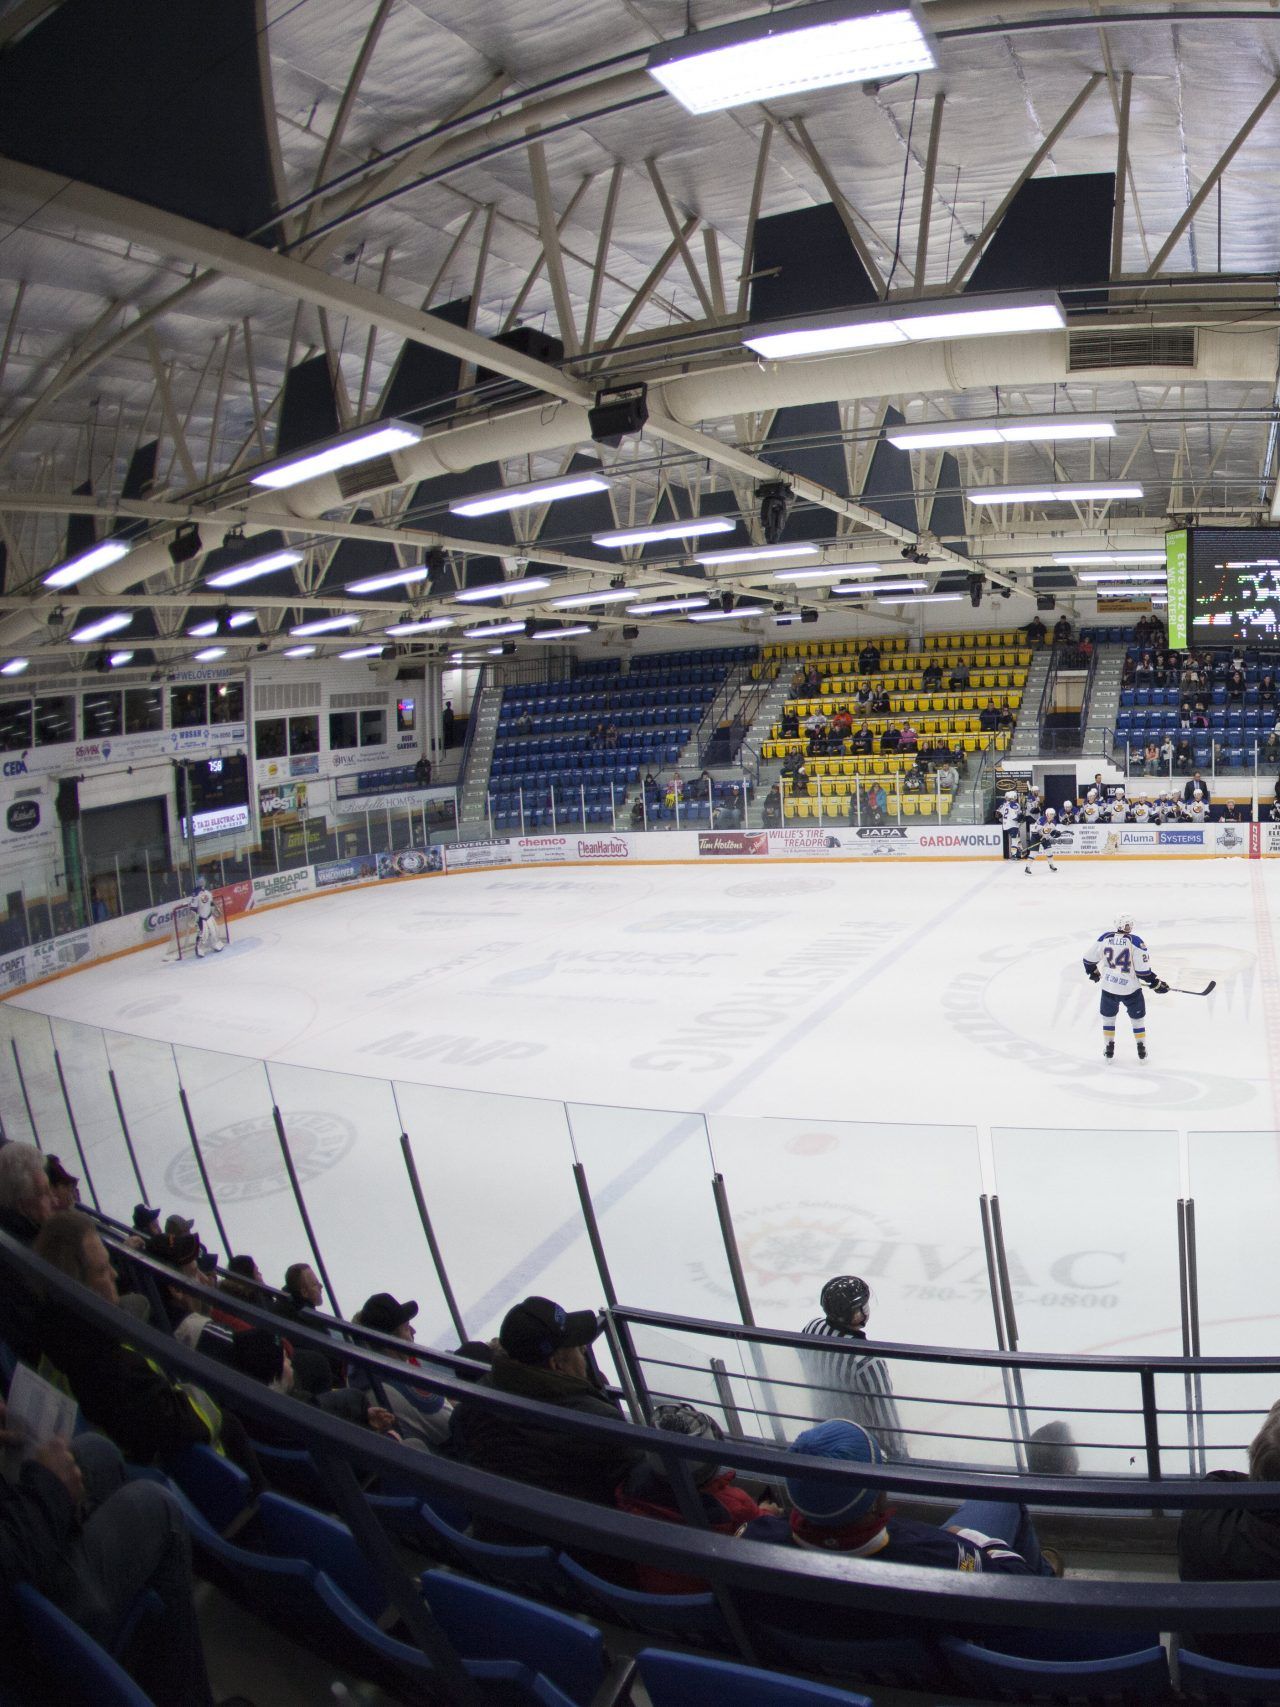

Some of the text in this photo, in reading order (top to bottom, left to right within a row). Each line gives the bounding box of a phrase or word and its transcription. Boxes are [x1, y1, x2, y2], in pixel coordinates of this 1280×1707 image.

[3, 761, 28, 777] CEDA
[211, 815, 235, 827] ELECTRIC
[769, 829, 825, 839] WILLIE'S TIRE
[920, 835, 1001, 847] GARDAWORLD
[1123, 833, 1154, 844] Aluma
[448, 839, 507, 850] COVERALLS
[518, 837, 566, 848] chemco
[578, 840, 628, 857] CleanHarbors
[699, 837, 743, 850] Tim Hortons
[254, 870, 308, 890] BILLBOARD
[265, 881, 299, 896] DIRECT
[144, 905, 193, 932] Casma
[550, 950, 739, 965] water
[355, 1030, 549, 1067] MNP
[820, 1236, 1127, 1292] HVAC
